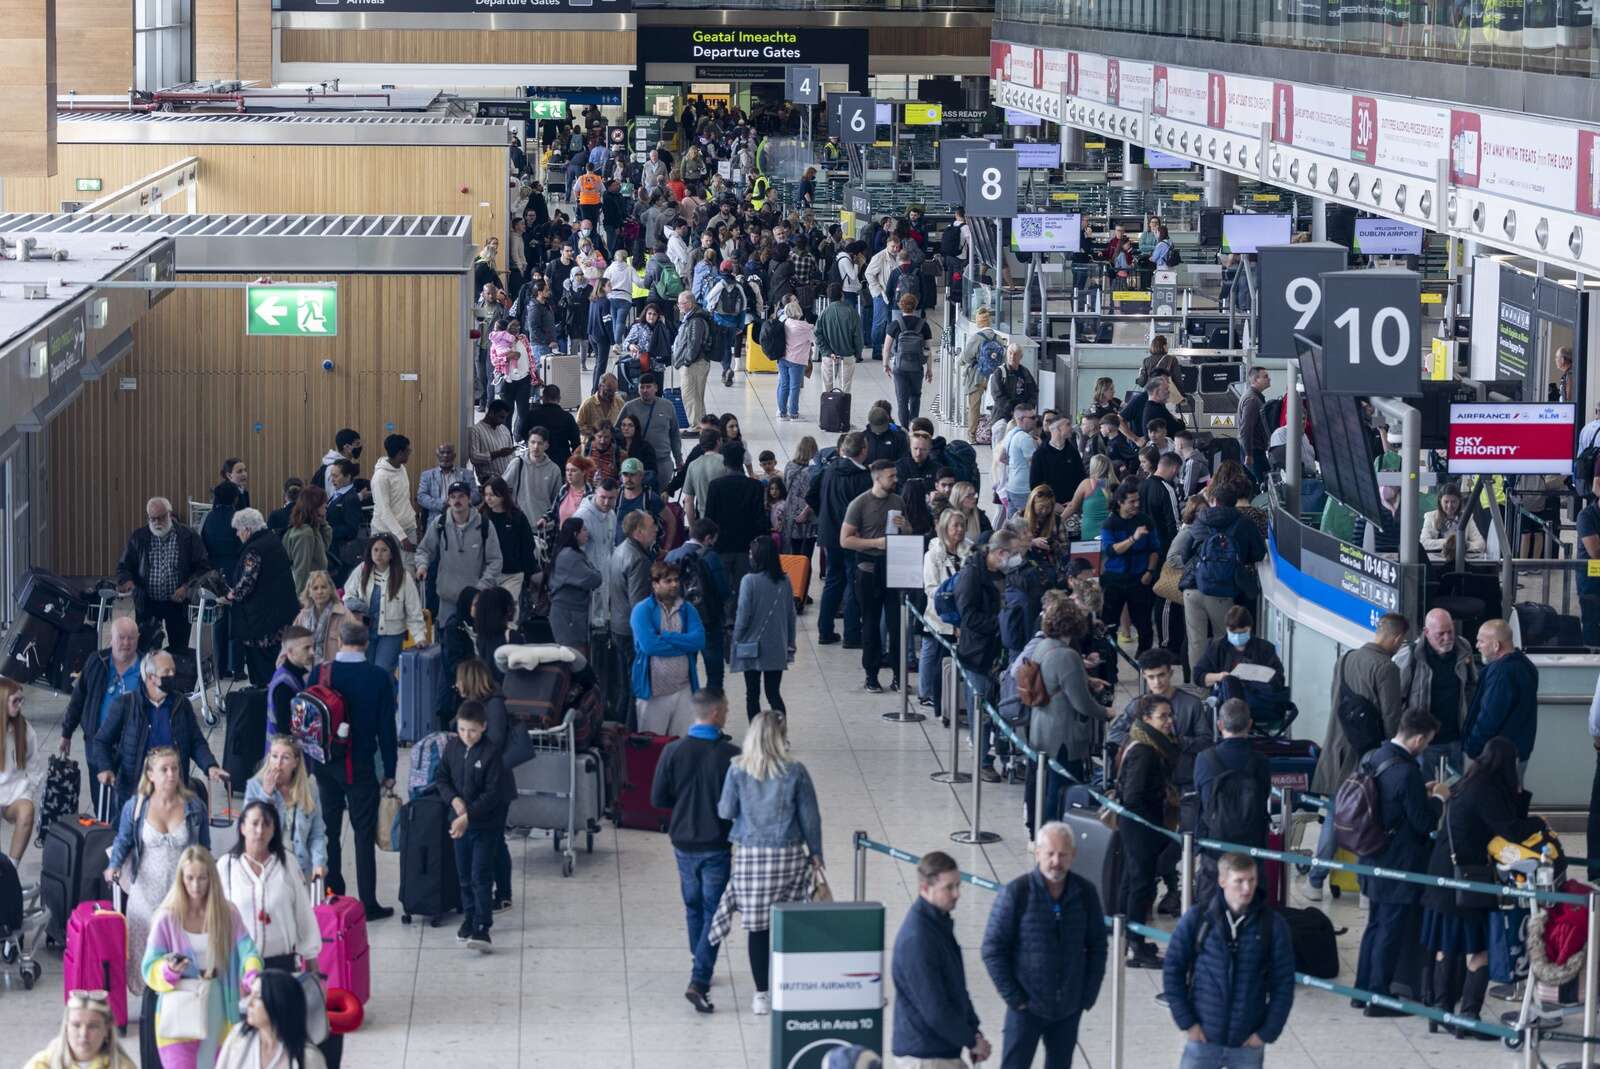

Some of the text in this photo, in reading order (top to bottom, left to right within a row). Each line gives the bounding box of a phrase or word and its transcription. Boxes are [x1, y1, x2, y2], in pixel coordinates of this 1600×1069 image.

[693, 31, 797, 43] Geataí Imeachta
[693, 46, 801, 60] Departure Gates
[799, 78, 811, 95] 4
[851, 109, 866, 132] 6
[1483, 142, 1491, 155] FLY
[1492, 144, 1505, 157] AWAY
[1506, 146, 1518, 160] WITH
[1519, 148, 1537, 164] TREATS
[1547, 152, 1557, 168] THE
[1558, 155, 1573, 170] LOOP
[981, 167, 1002, 200] 8
[1285, 277, 1322, 330] 9
[1334, 306, 1410, 366] 10
[1455, 436, 1483, 446] SKY
[1454, 446, 1517, 455] PRIORITY
[1364, 556, 1381, 577] 10-14
[780, 981, 862, 991] BRITISH AIRWAYS
[786, 1018, 874, 1031] Check in Area 10
